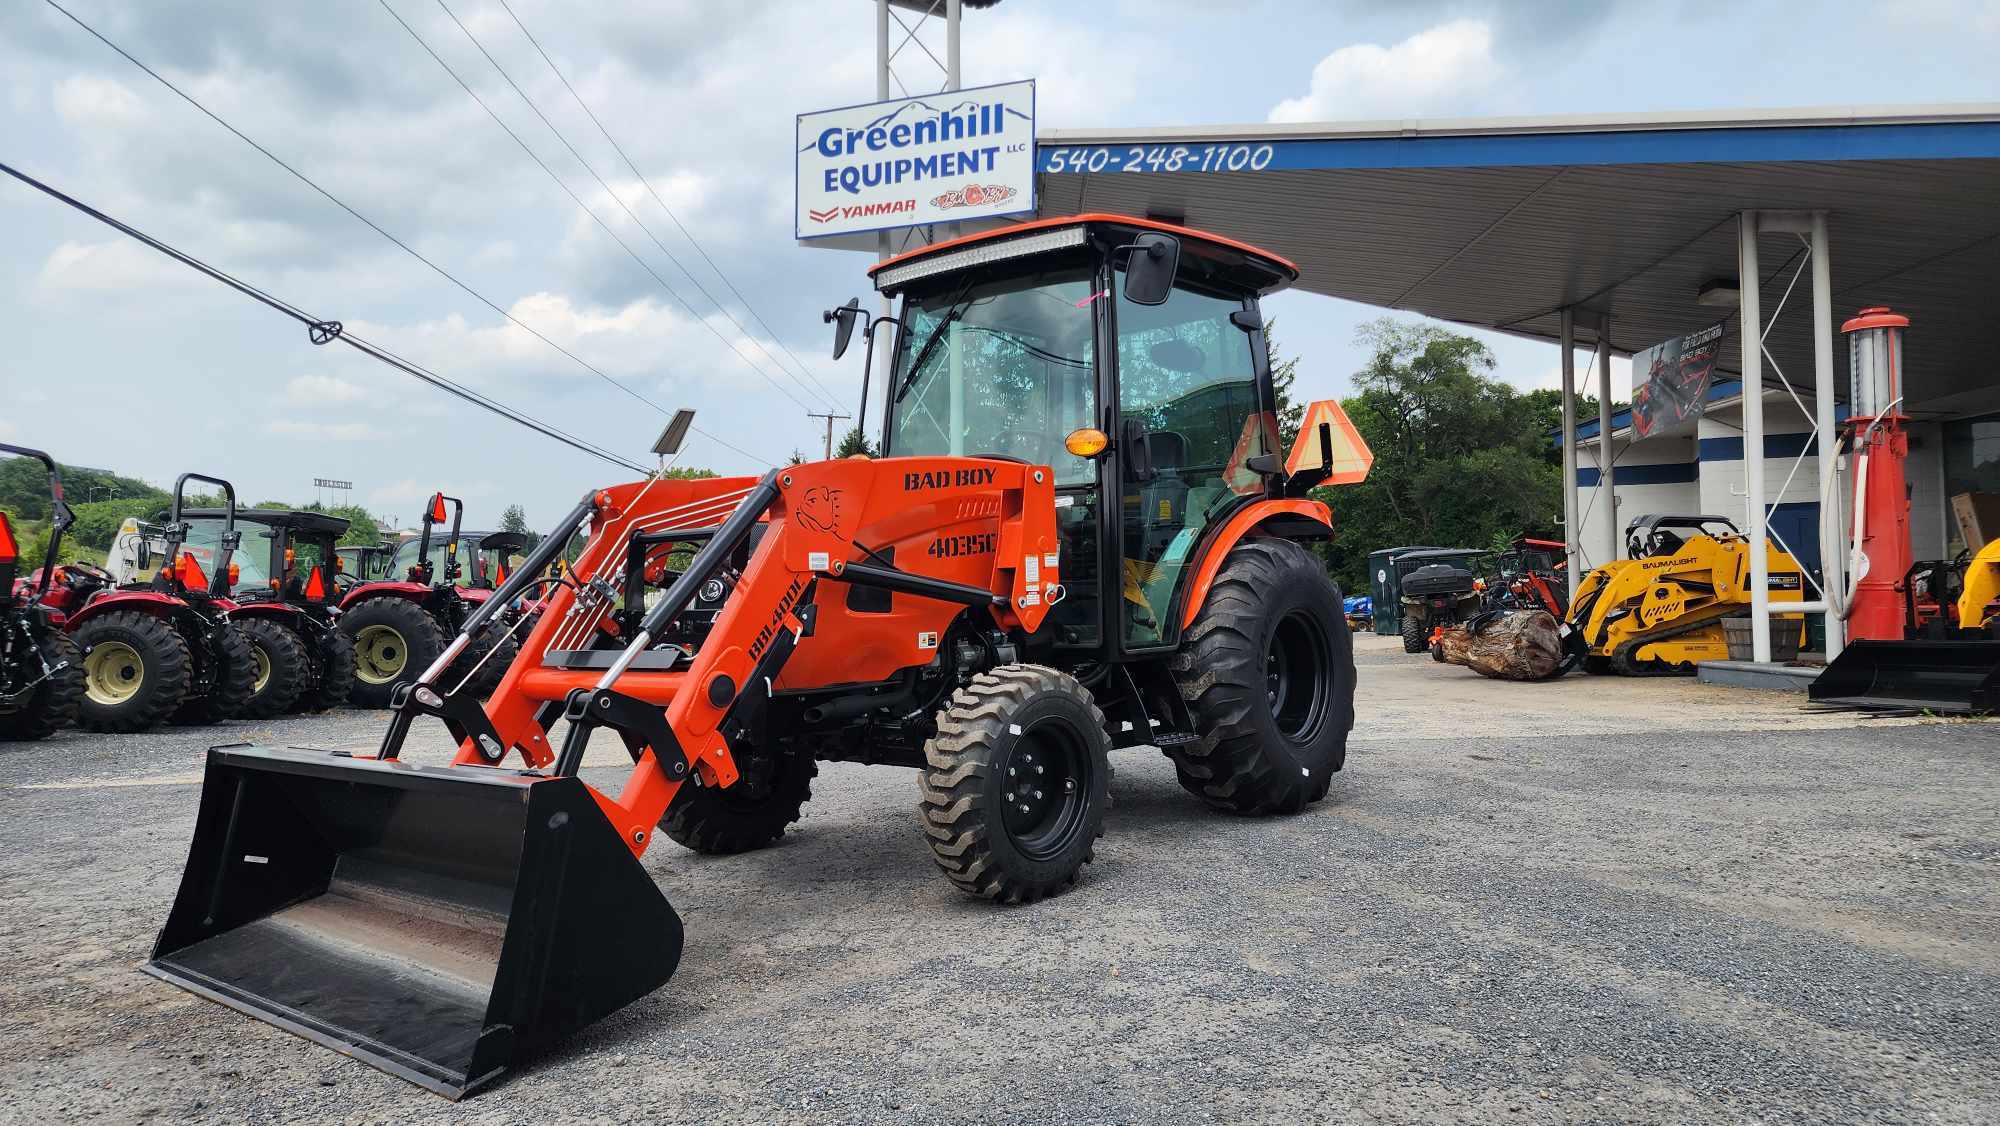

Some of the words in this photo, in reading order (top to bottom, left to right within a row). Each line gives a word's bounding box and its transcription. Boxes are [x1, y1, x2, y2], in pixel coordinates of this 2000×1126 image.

[817, 103, 1004, 157] Greenhill
[824, 146, 1001, 194] EQUIPMENT
[1006, 143, 1026, 153] LLC
[1045, 145, 1273, 173] 540-248-1100
[841, 199, 916, 219] YANMAR
[904, 471, 950, 491] BAD
[955, 466, 997, 487] BOY
[1642, 557, 1698, 569] BAUMALIGHT
